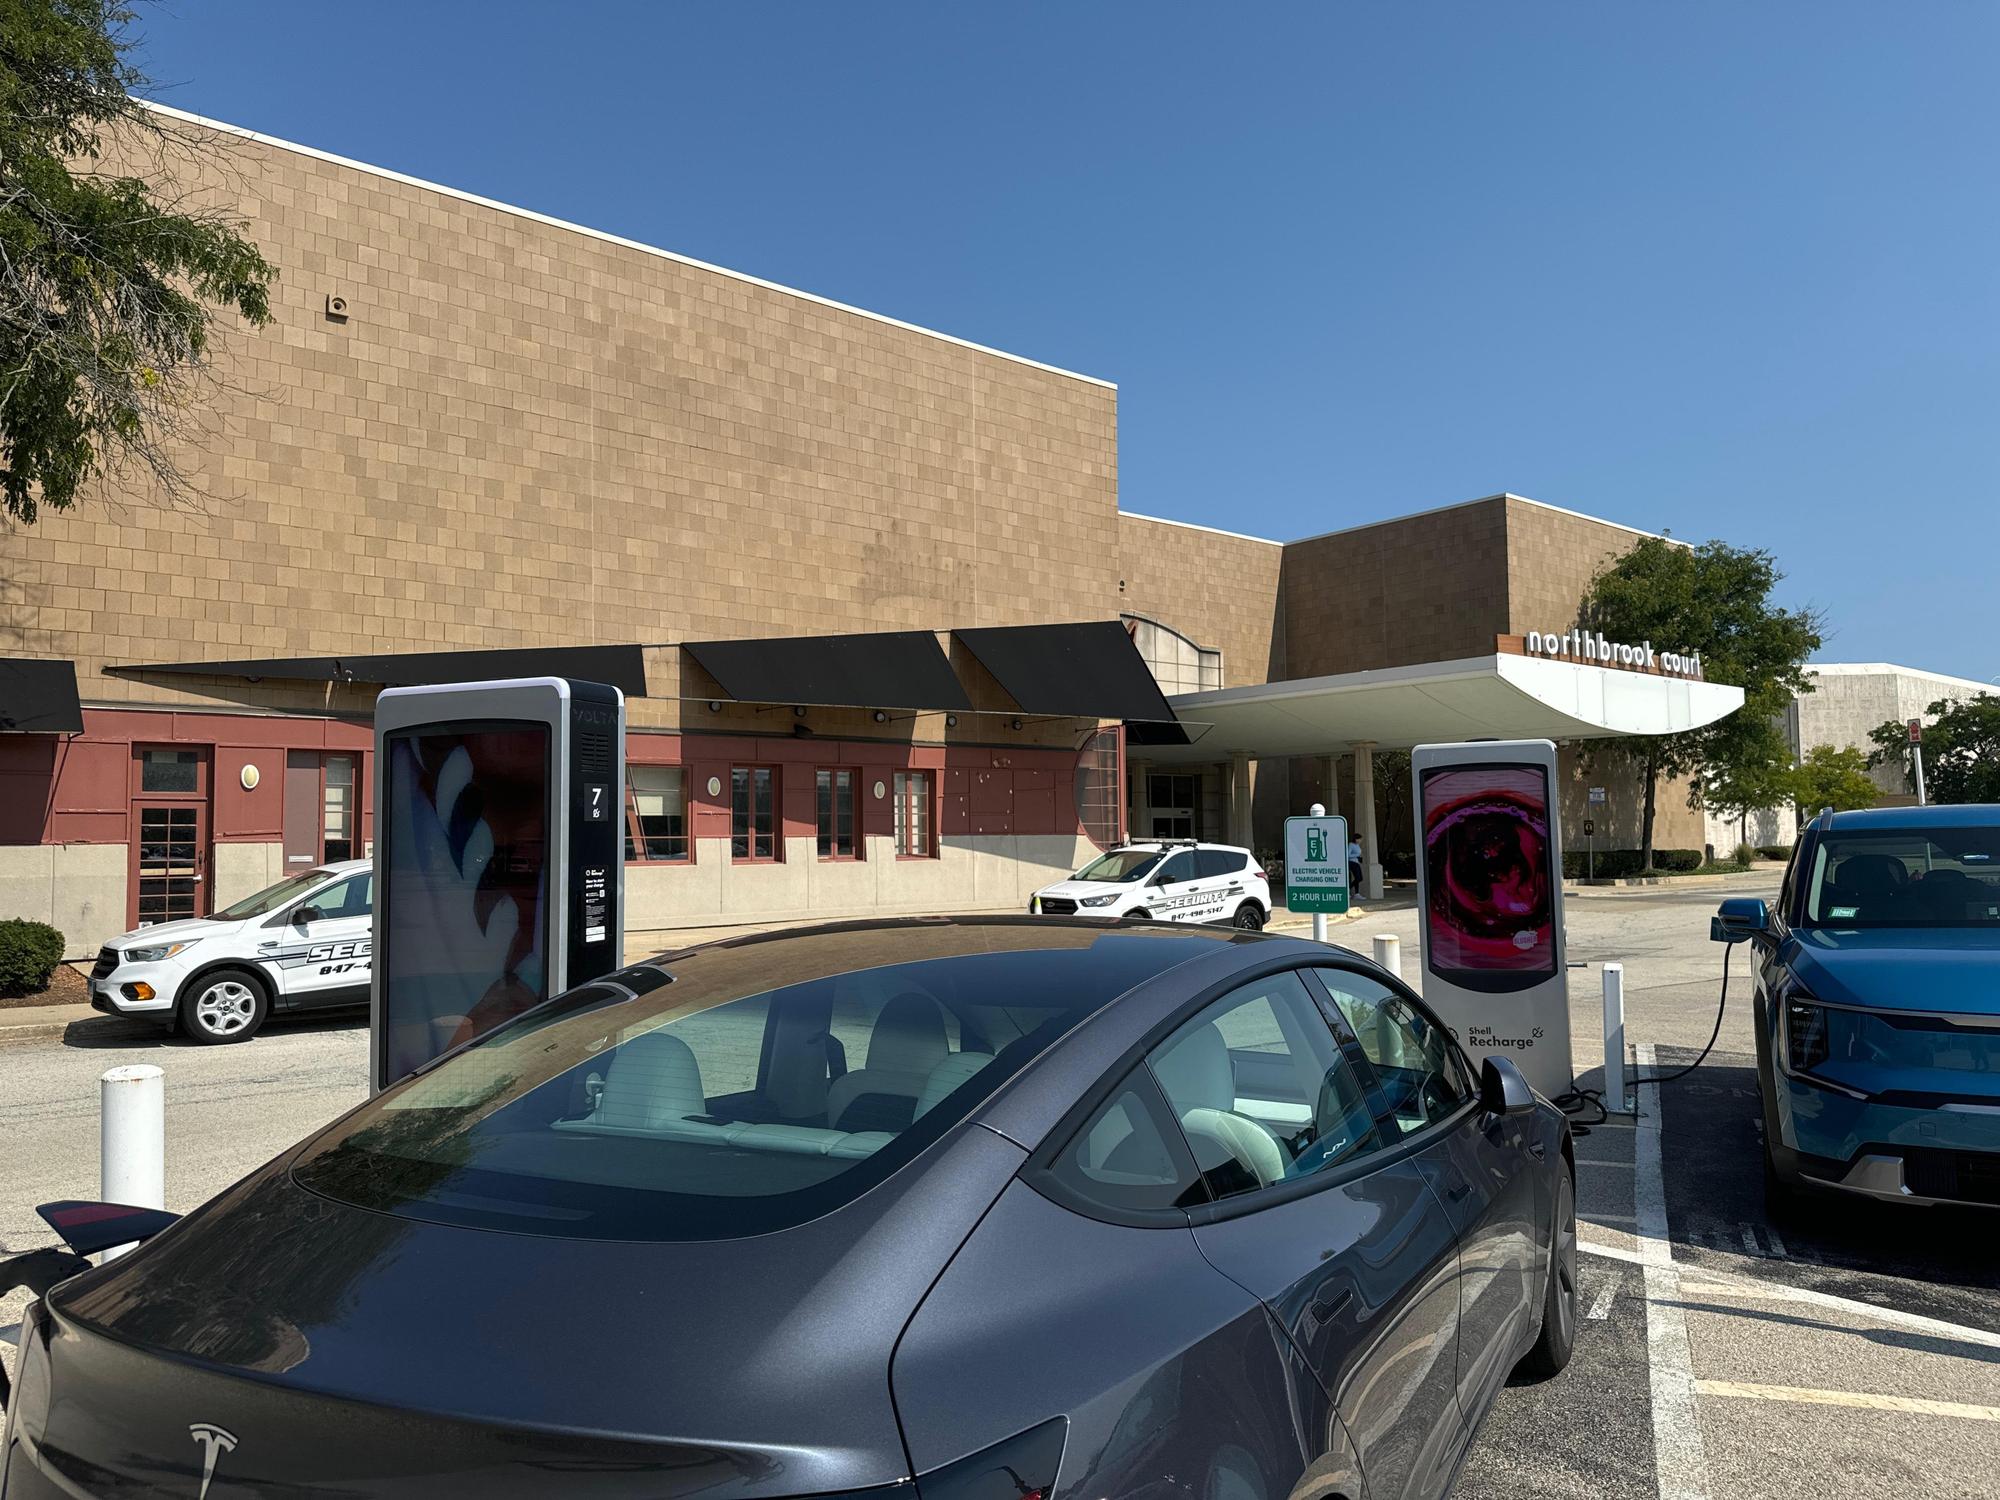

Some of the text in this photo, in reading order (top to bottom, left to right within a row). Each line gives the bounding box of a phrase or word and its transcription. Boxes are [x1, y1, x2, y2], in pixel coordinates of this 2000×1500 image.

[1527, 628, 1701, 676] northbrook court
[592, 787, 602, 805] 7
[1292, 867, 1342, 875] ELECTRIC VEHICLE
[1166, 889, 1230, 910] SECURITY
[1292, 893, 1343, 902] 2 HOUR LIMIT
[306, 941, 371, 963] SEC
[319, 962, 371, 975] 847-4
[1468, 1026, 1492, 1035] Shell
[1469, 1035, 1534, 1049] Recharge
